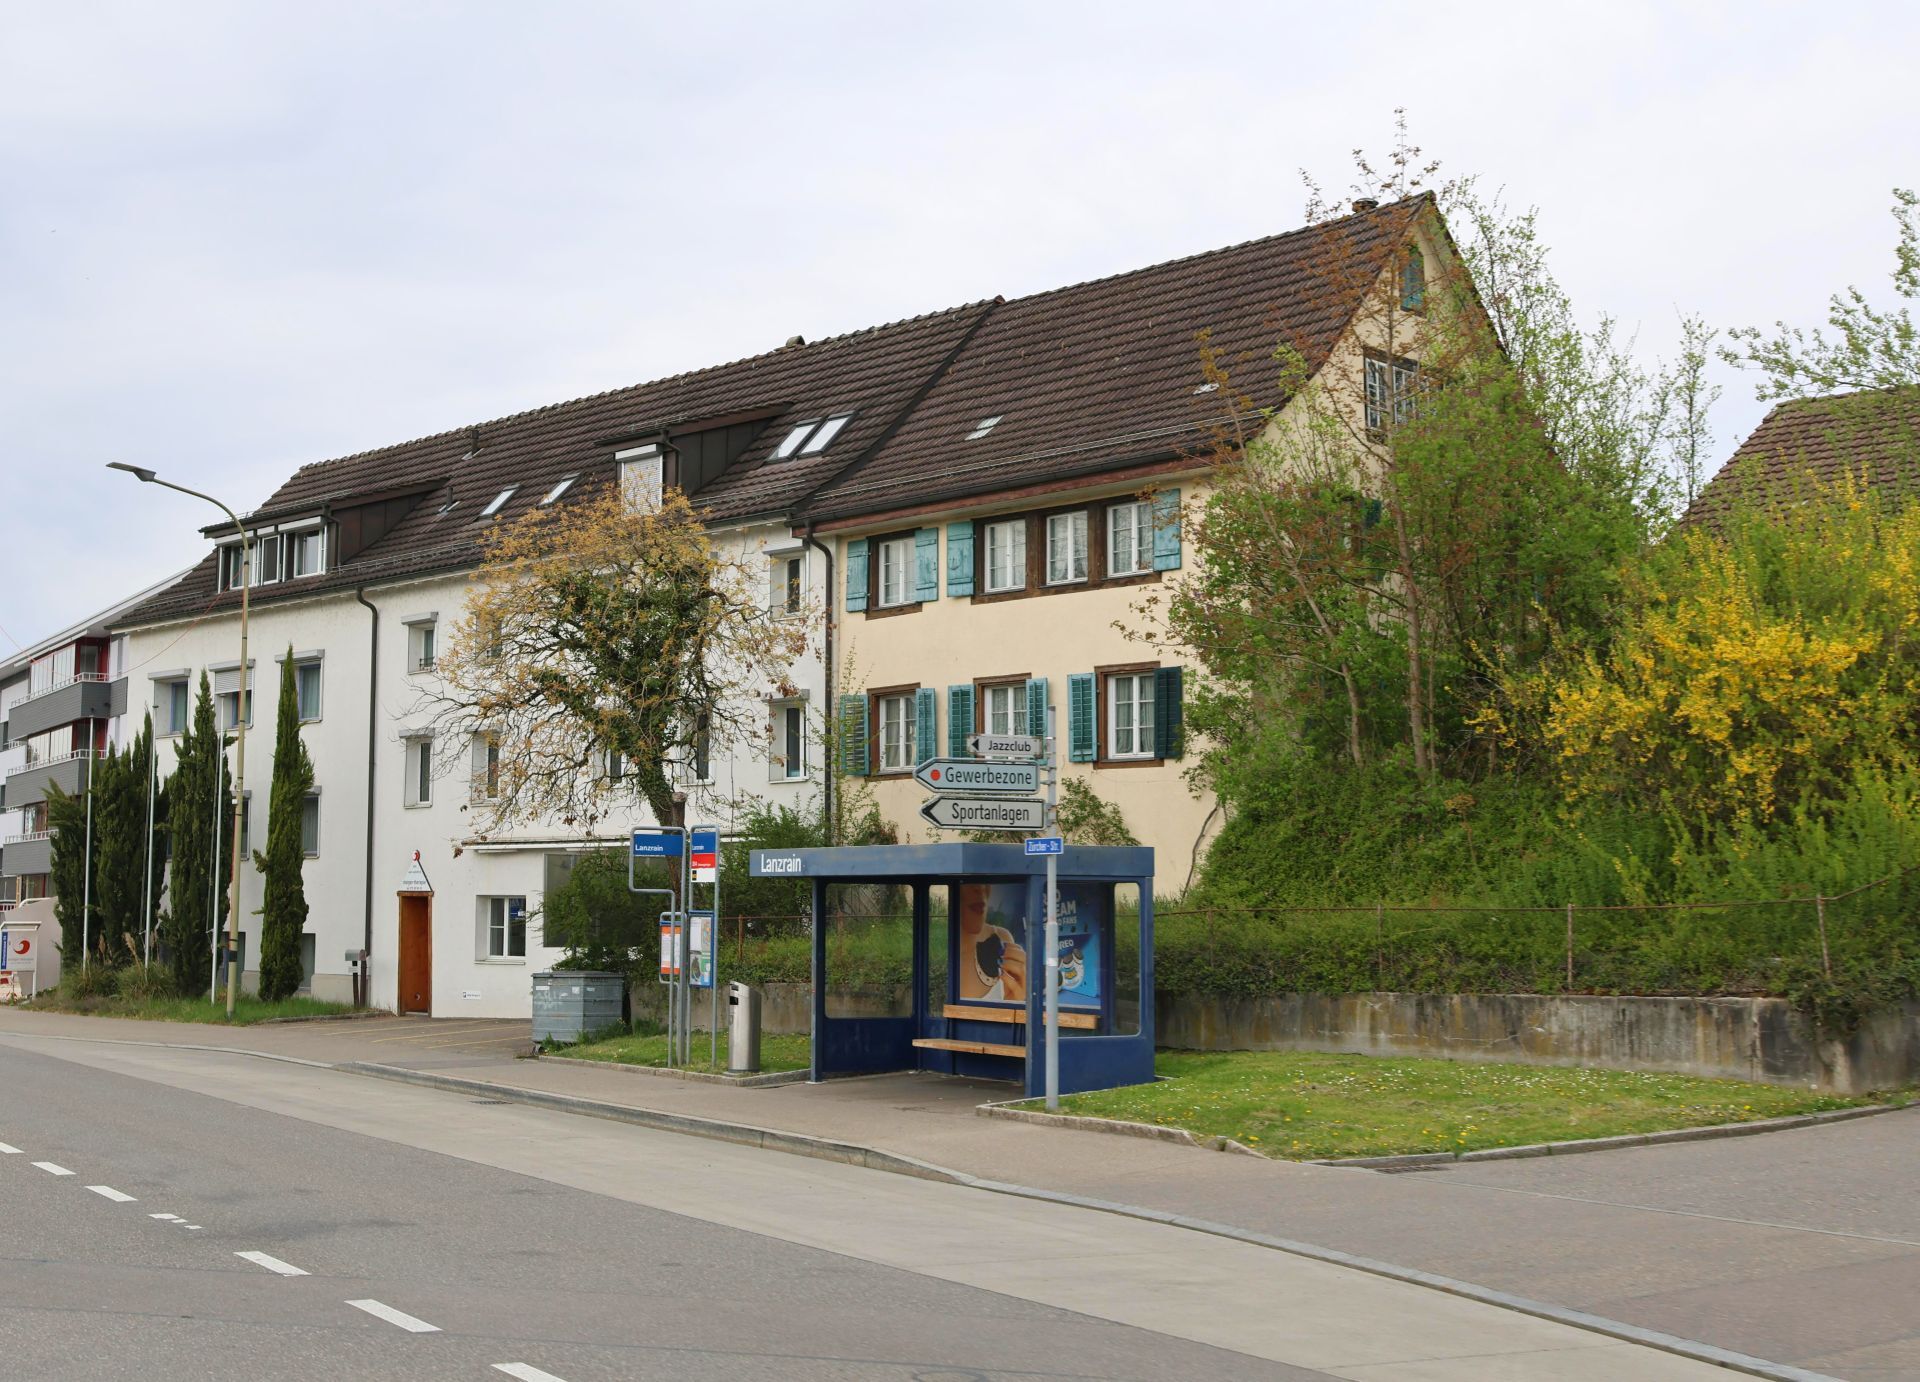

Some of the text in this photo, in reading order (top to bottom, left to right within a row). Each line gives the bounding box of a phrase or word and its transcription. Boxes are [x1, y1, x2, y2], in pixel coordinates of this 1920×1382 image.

[988, 740, 1031, 752] Jazzclub
[945, 767, 1032, 785] Gewerbezone
[951, 802, 1029, 825] Sportanlagen
[635, 844, 663, 852] Lanzrain
[761, 853, 802, 873] Lanzrain
[1057, 939, 1074, 952] REO
